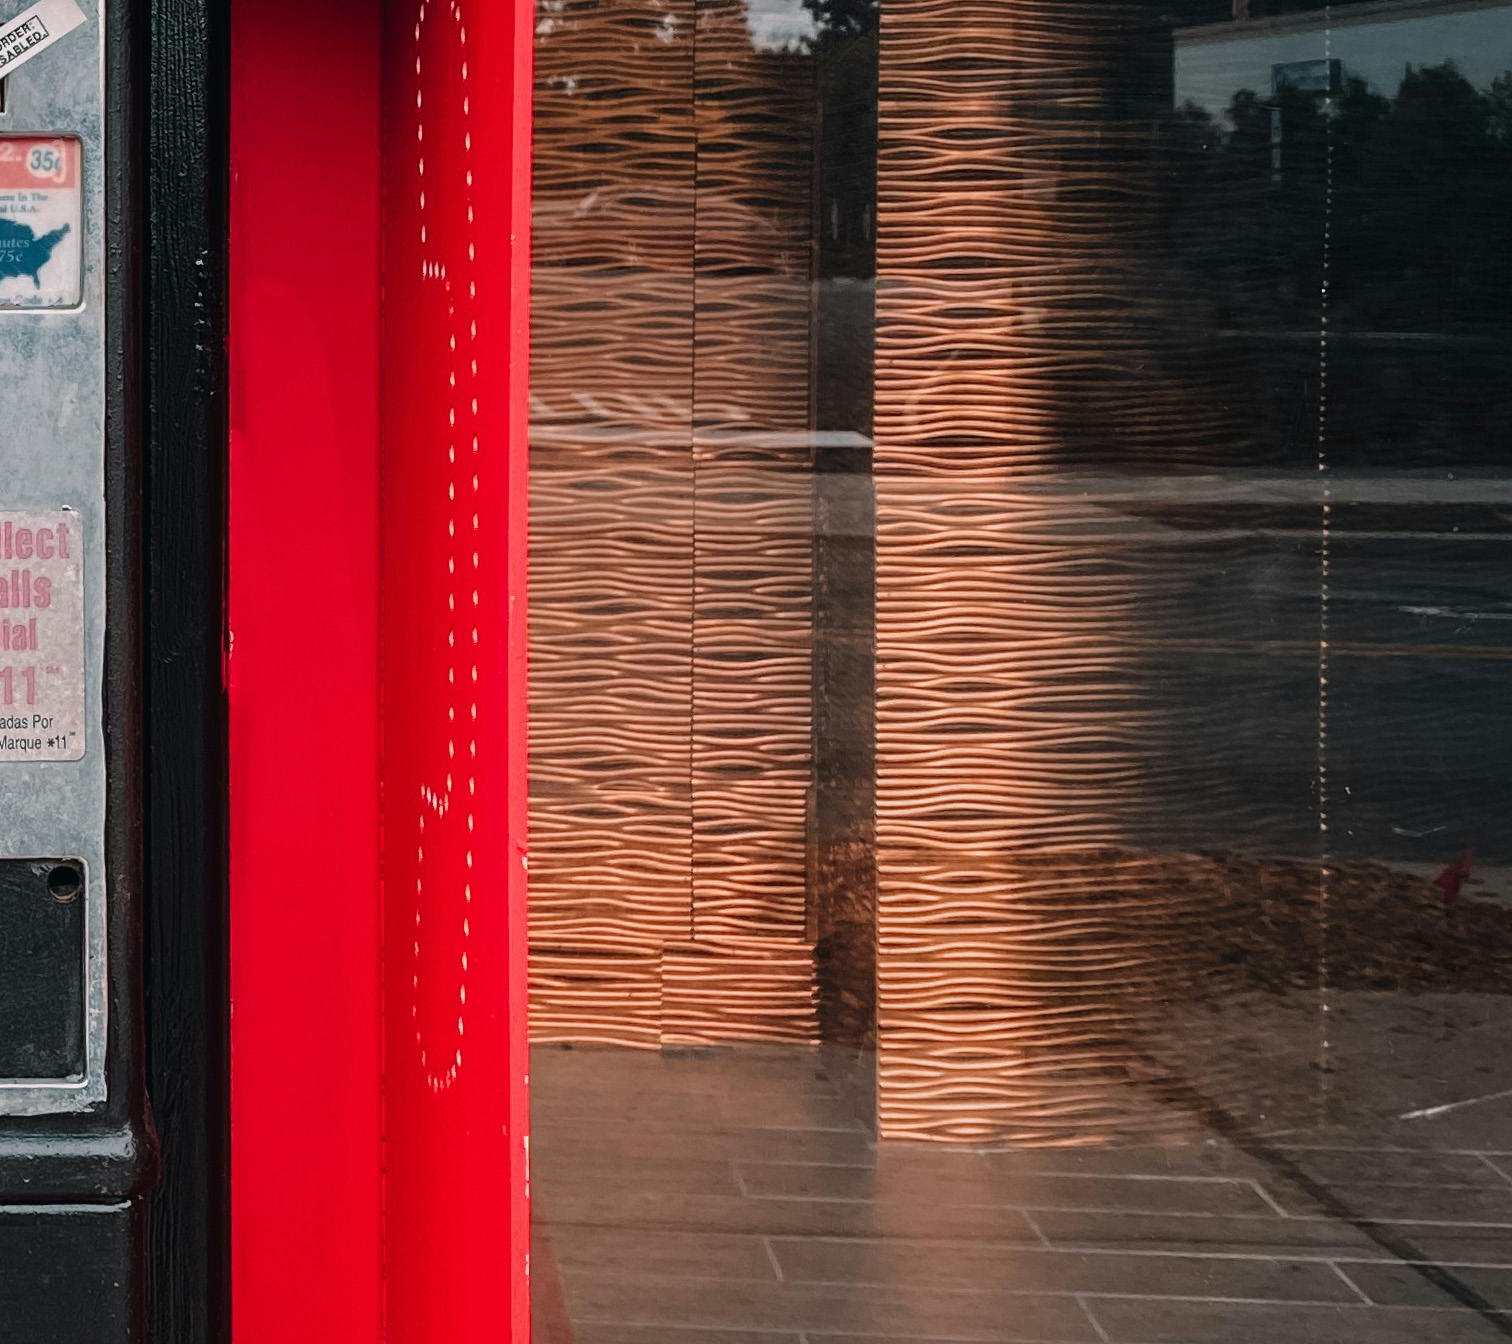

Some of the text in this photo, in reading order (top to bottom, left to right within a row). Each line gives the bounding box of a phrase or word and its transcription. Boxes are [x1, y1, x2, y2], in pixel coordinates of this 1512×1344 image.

[18, 193, 28, 202] In
[31, 193, 48, 202] The
[32, 714, 54, 729] Por
